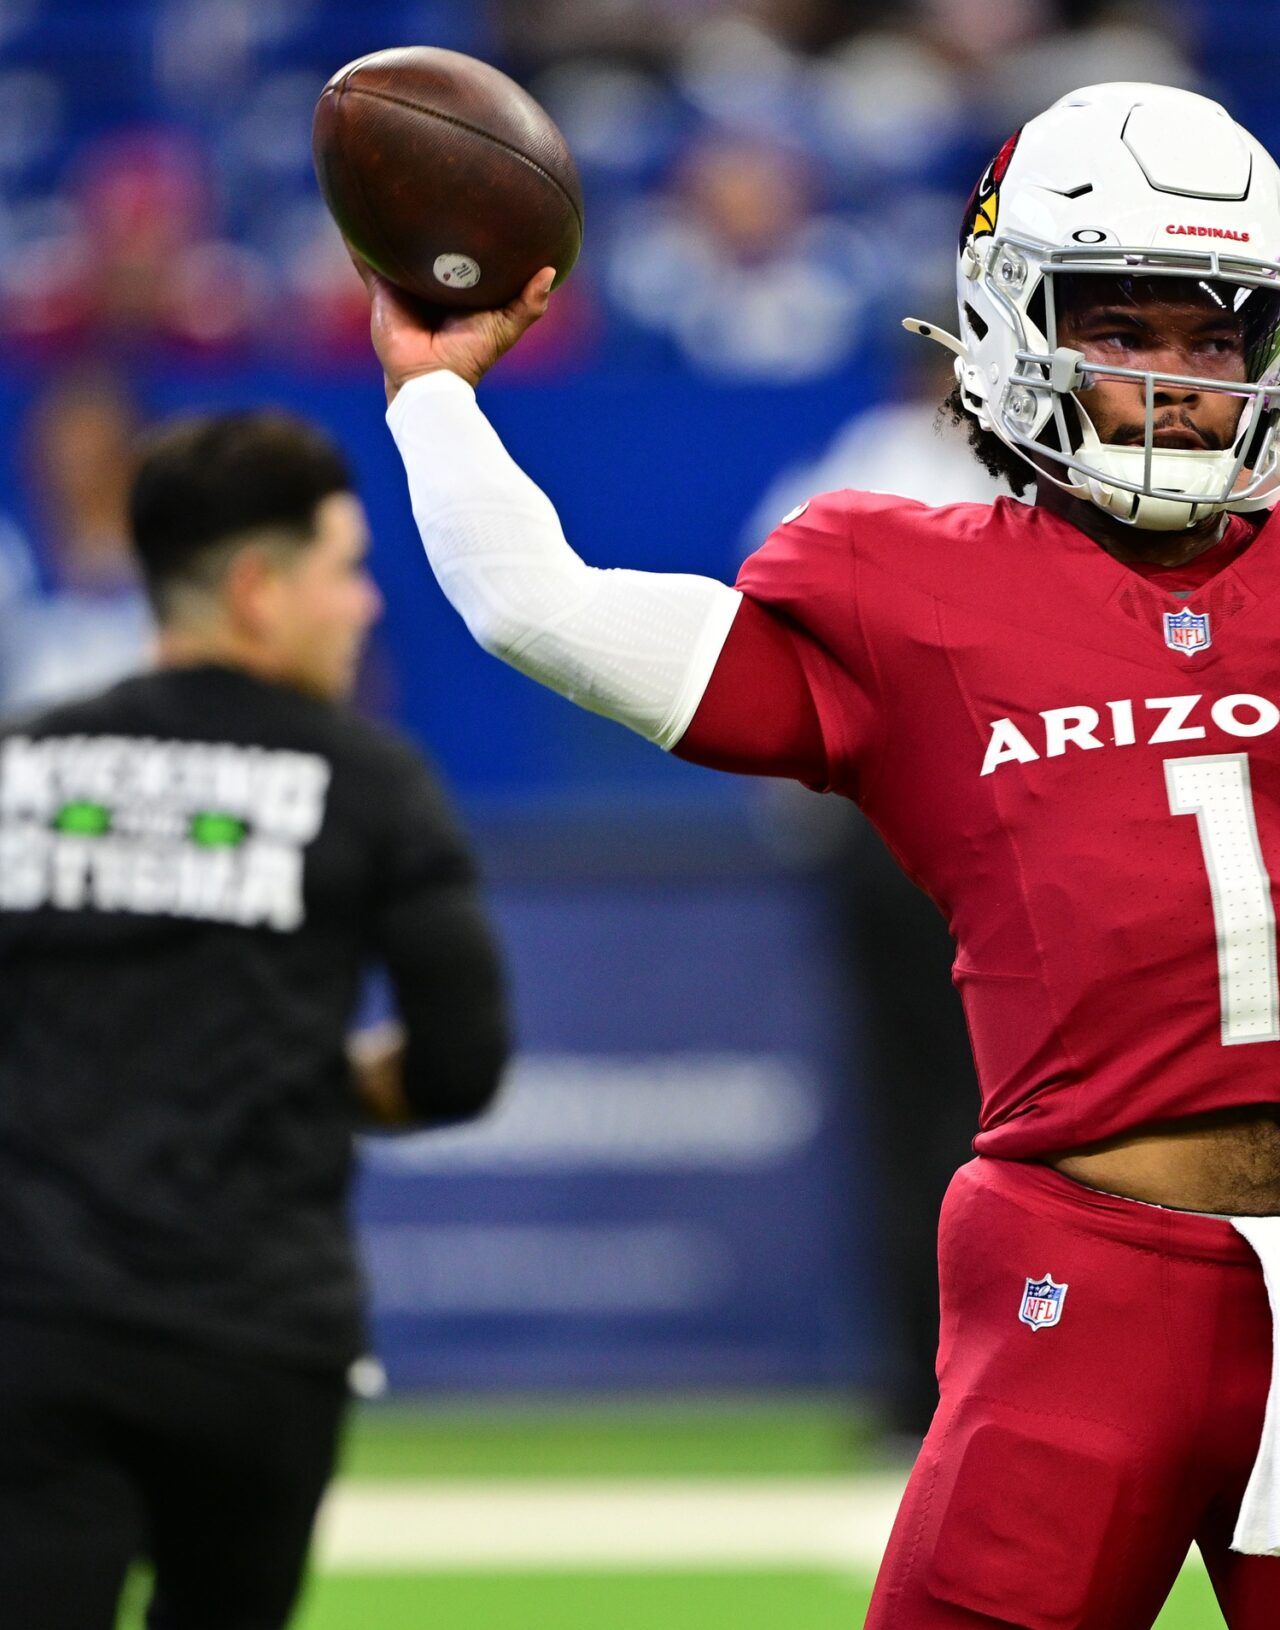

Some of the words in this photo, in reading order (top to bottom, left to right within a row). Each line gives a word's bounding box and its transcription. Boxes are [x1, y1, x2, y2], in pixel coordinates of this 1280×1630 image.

[1166, 224, 1250, 243] CARDINALS
[1173, 628, 1204, 645] NFL
[1162, 752, 1280, 1047] 1
[1025, 1298, 1053, 1320] NFL
